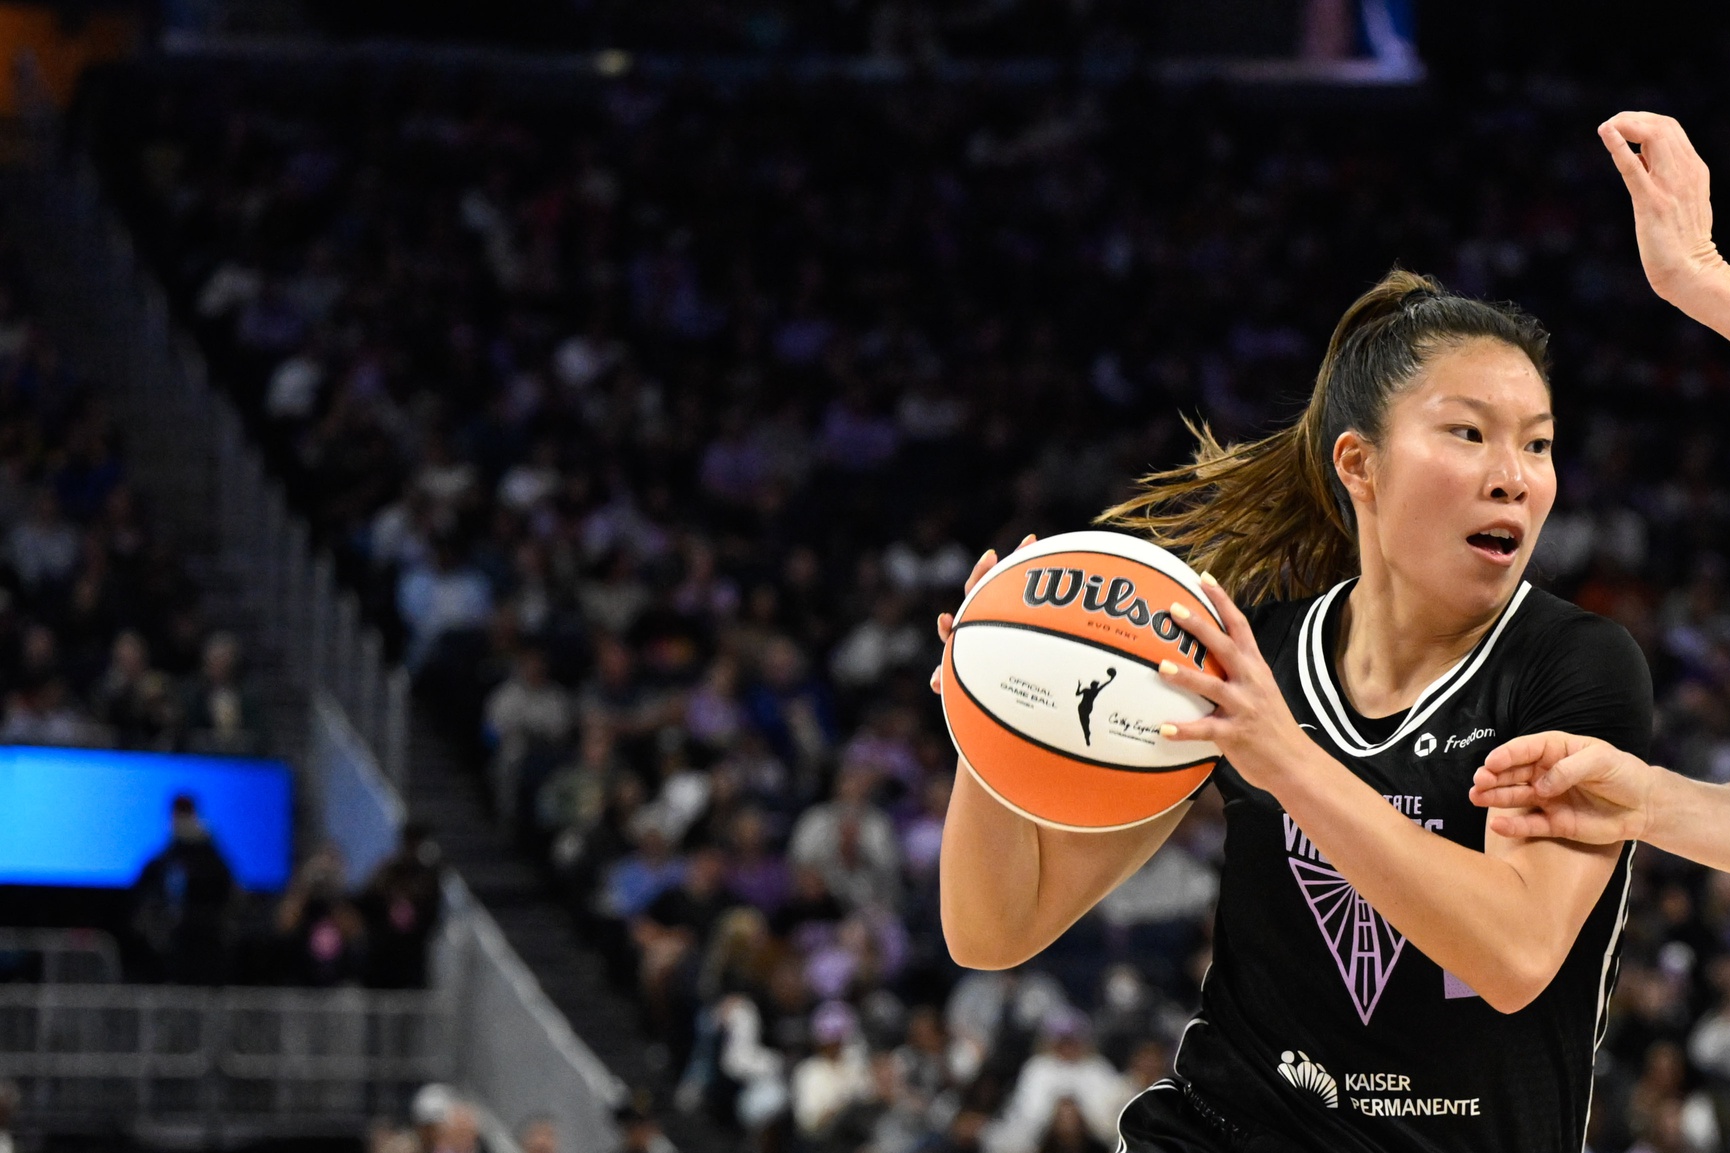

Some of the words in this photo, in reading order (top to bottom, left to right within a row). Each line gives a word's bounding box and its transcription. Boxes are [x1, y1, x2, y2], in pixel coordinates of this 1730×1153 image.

[1022, 566, 1208, 673] Wilson
[1000, 682, 1029, 698] GAME
[1031, 694, 1058, 710] BALL
[1443, 727, 1496, 754] freedom
[1382, 794, 1423, 815] TATE
[1344, 1072, 1412, 1092] KAISER
[1350, 1097, 1481, 1117] PERMANENTE
